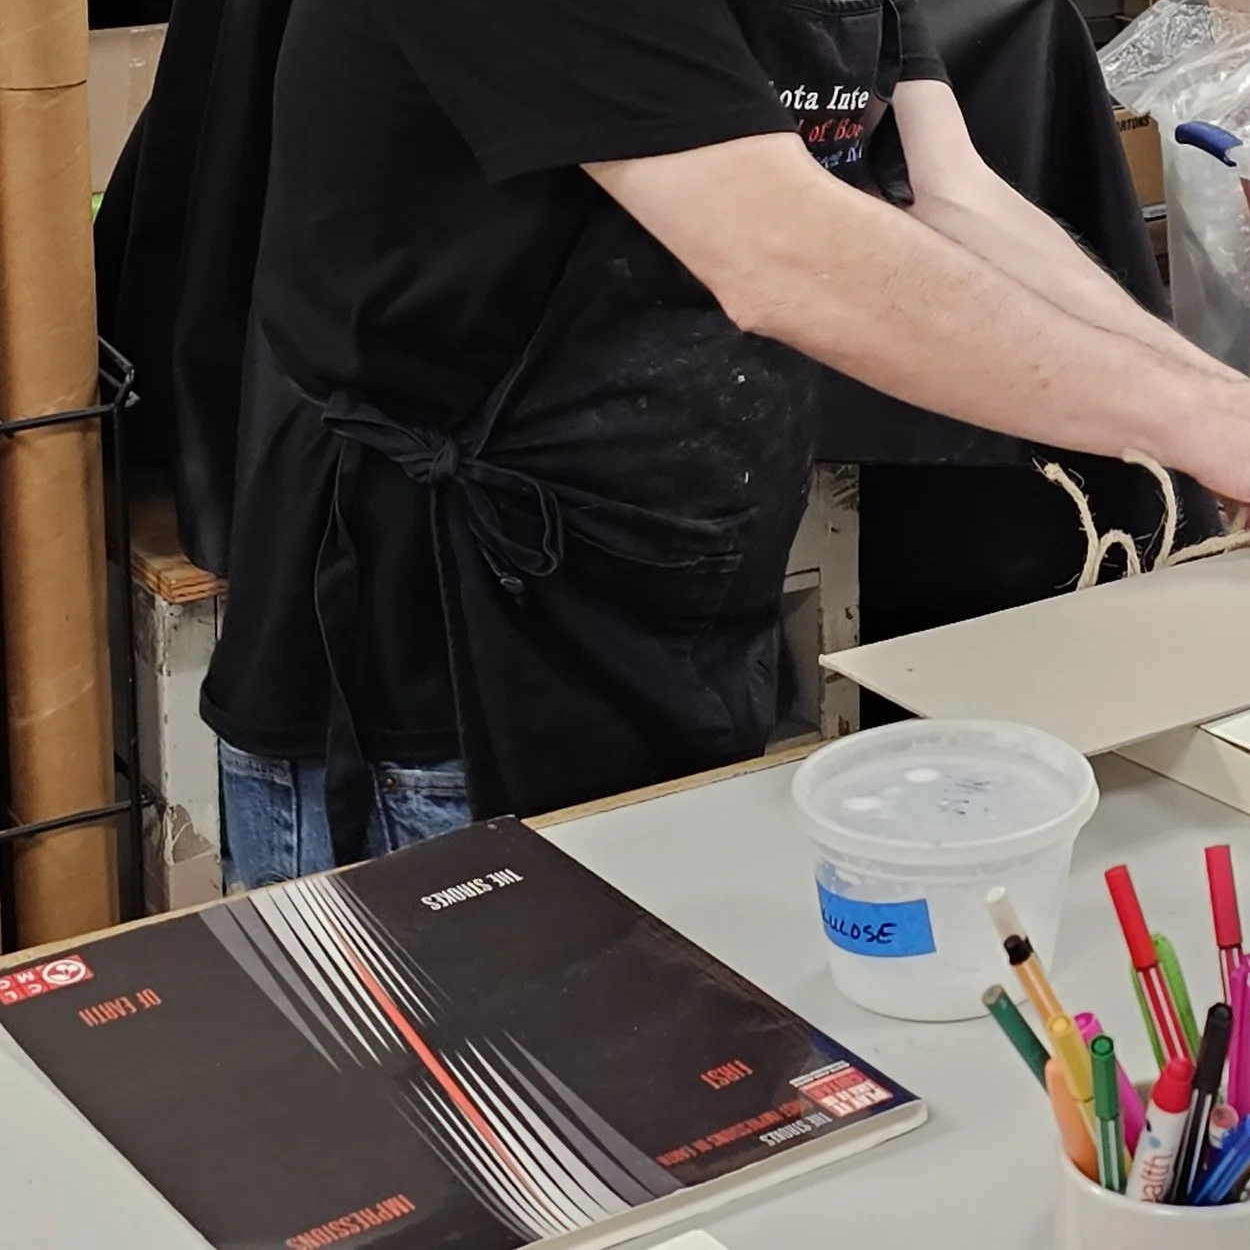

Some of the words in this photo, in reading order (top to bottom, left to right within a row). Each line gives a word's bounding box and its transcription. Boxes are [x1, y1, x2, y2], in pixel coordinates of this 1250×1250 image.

[780, 84, 820, 110] ota
[826, 85, 869, 110] Inte
[485, 868, 524, 888] THE
[421, 878, 493, 911] STROKES
[78, 996, 137, 1028] EARTH
[136, 988, 162, 1010] OF
[700, 1059, 754, 1090] FIRST
[759, 1120, 812, 1147] STROKES
[804, 1111, 833, 1128] THE
[1141, 1152, 1174, 1203] alth
[284, 1193, 416, 1250] IMPRESSIONS
